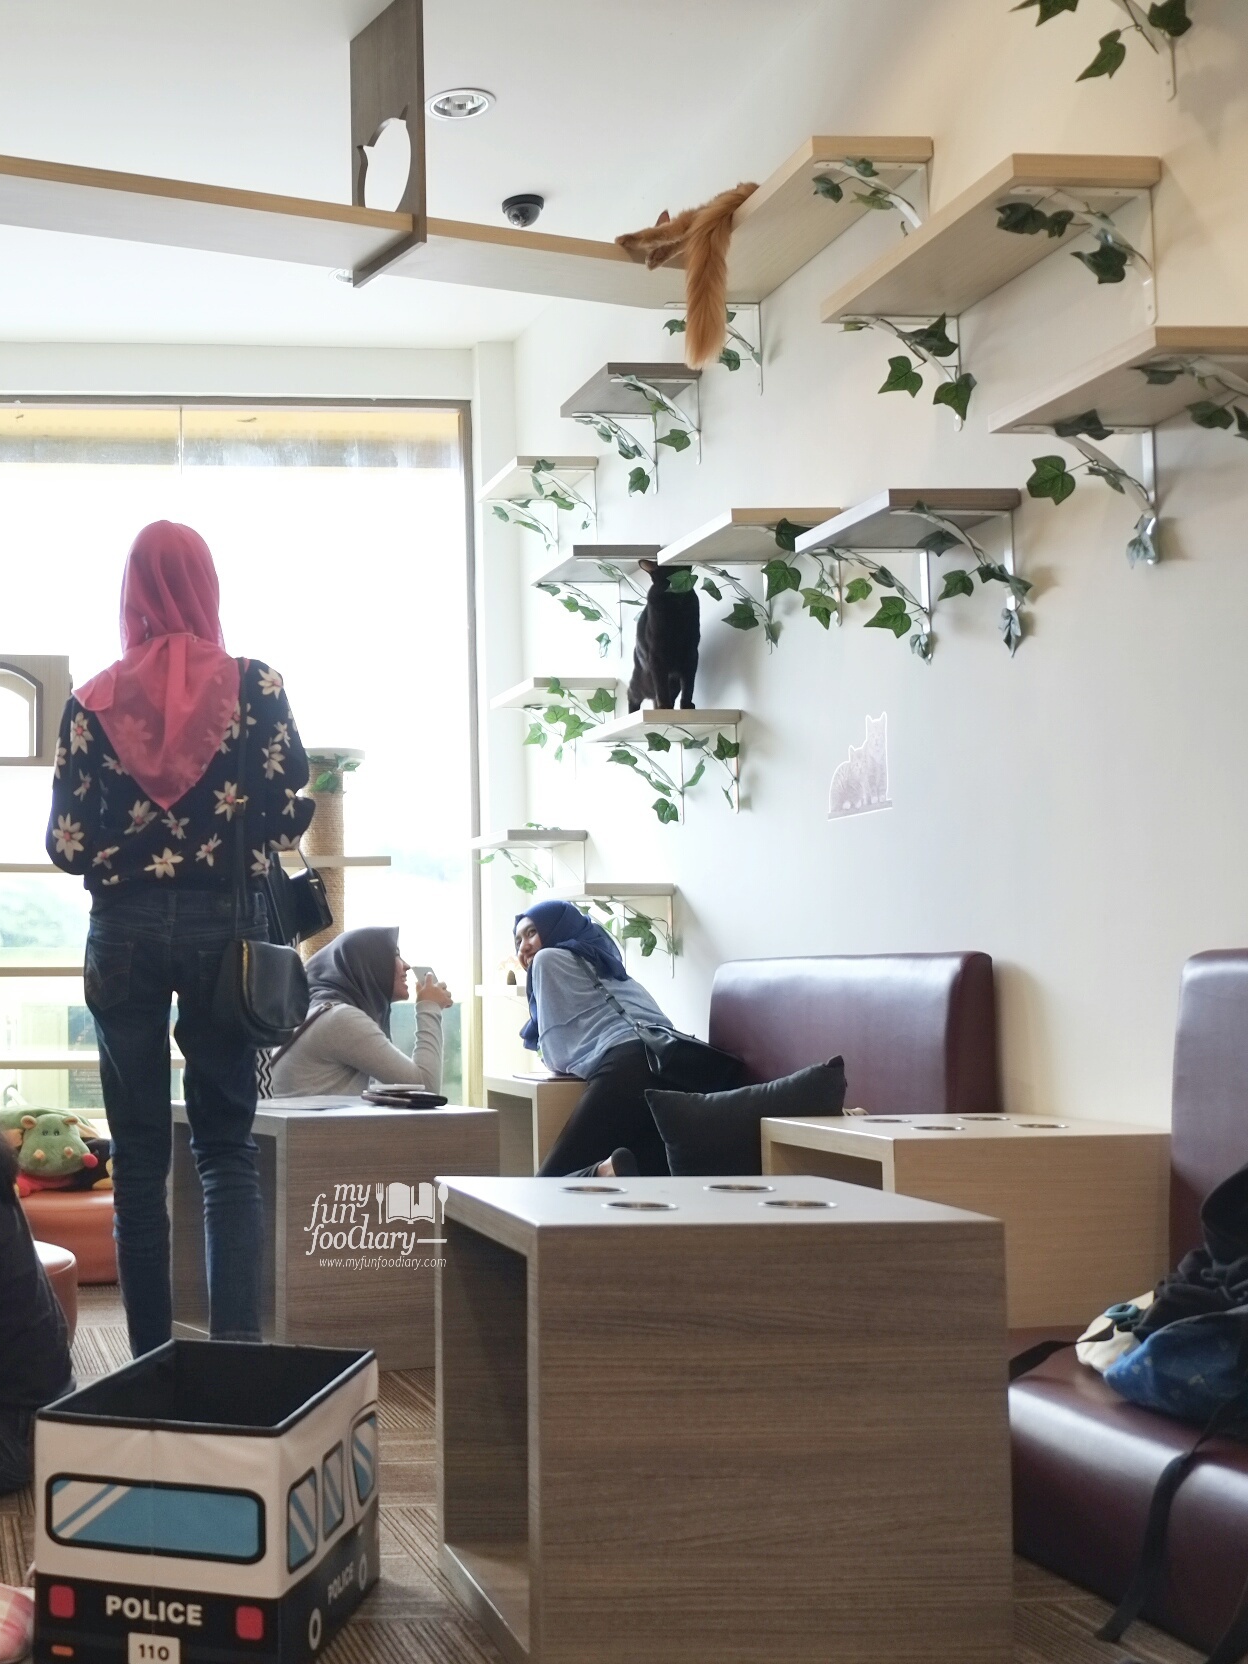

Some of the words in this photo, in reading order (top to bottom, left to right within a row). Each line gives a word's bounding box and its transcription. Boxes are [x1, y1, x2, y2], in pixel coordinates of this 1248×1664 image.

[327, 1561, 354, 1605] POLICE
[105, 1594, 203, 1626] POLICE
[138, 1643, 170, 1661] 110
